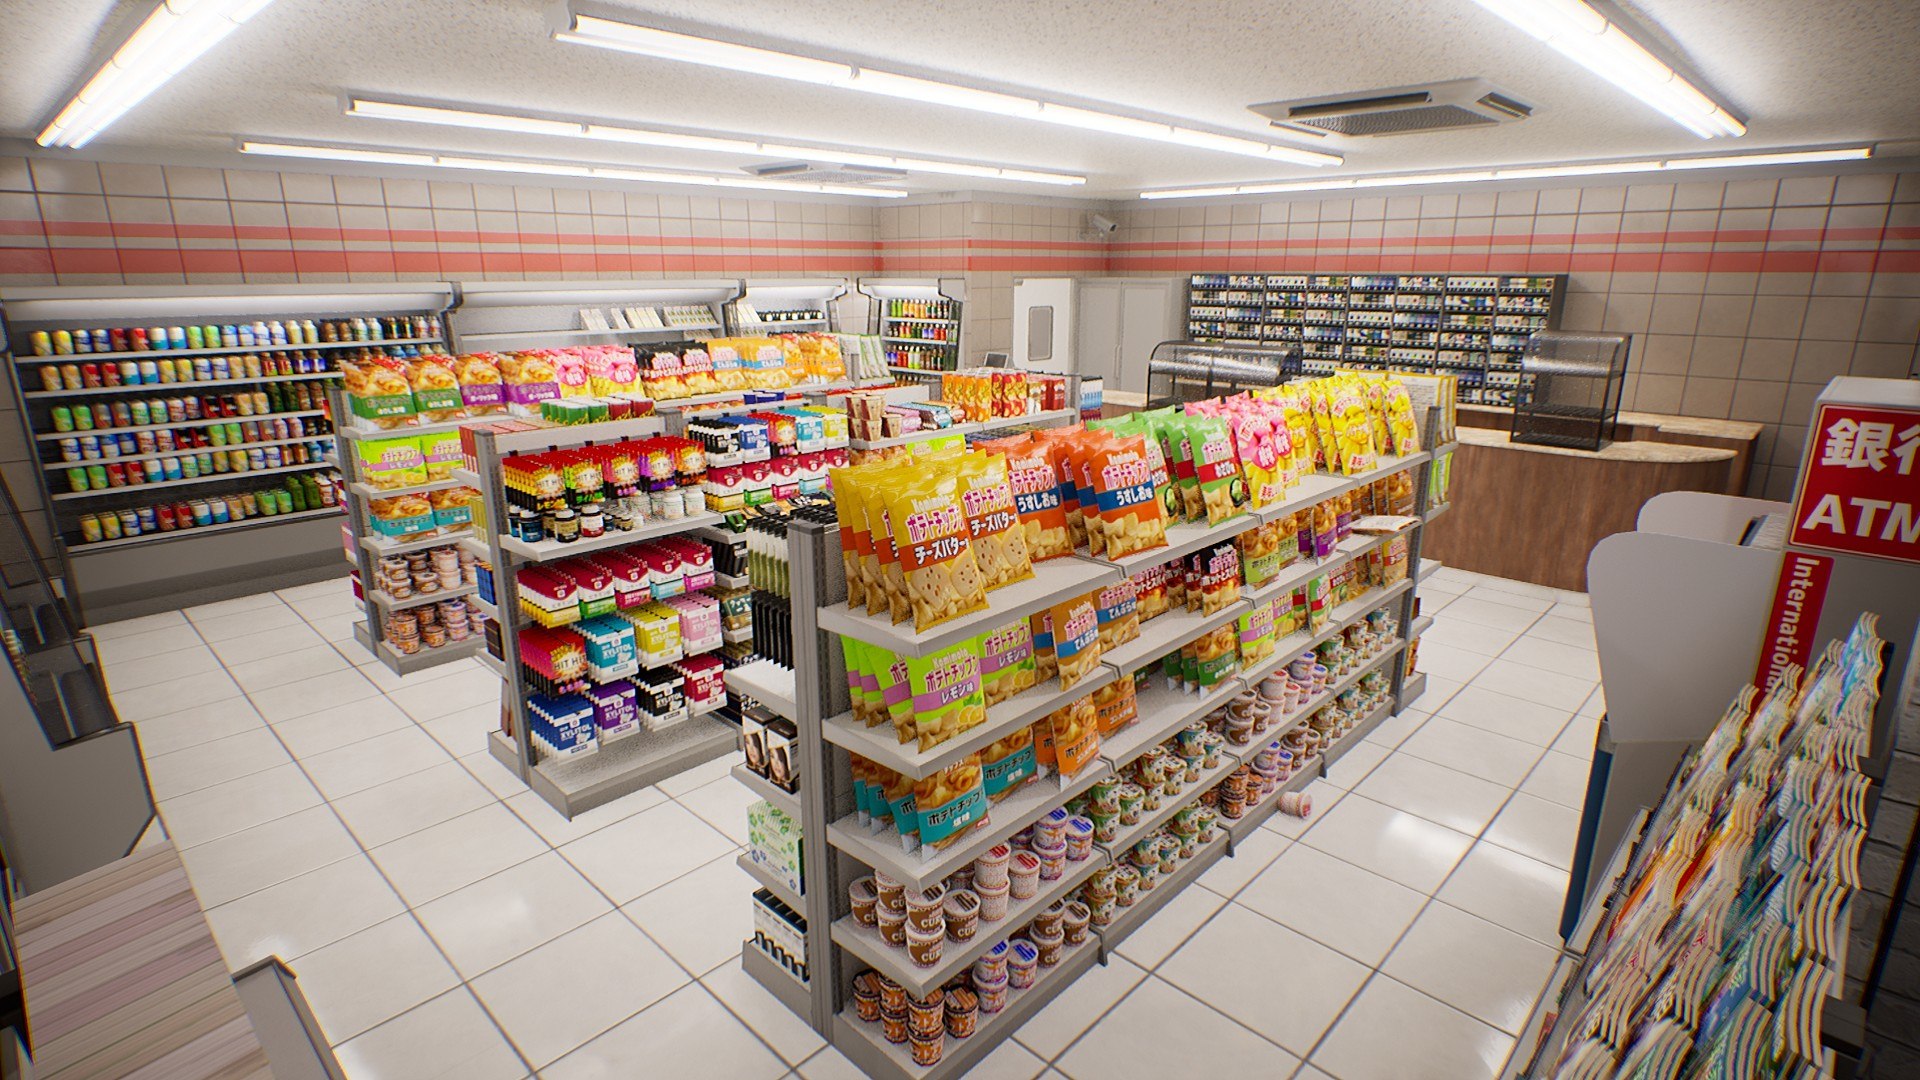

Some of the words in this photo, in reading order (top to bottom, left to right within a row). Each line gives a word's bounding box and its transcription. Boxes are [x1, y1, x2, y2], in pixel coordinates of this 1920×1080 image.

[1018, 492, 1058, 513] うすしお味
[1116, 485, 1154, 506] うすしお味
[1801, 493, 1920, 544] ATM
[1765, 556, 1820, 693] Internationa
[602, 643, 633, 659] XYLITOL
[998, 648, 1027, 668] レモン味
[697, 678, 723, 692] XYLITOL
[941, 681, 974, 705] レモン味
[656, 692, 683, 708] XYLITOL
[605, 704, 634, 719] XYLITOL
[560, 723, 592, 739] XYLITOL
